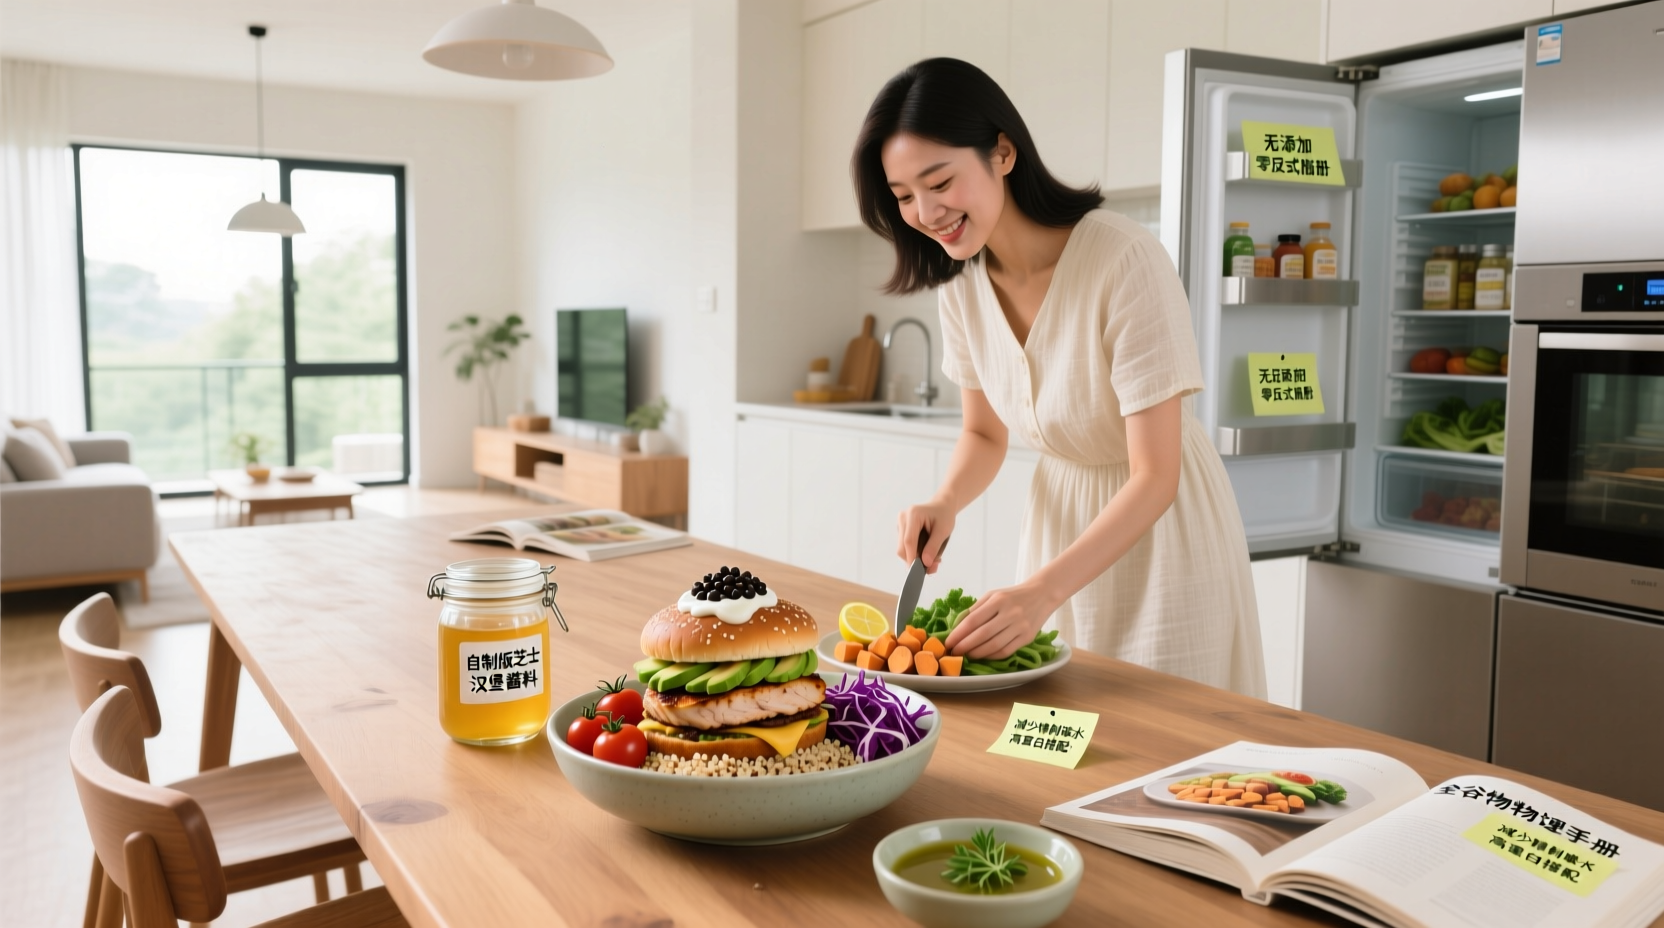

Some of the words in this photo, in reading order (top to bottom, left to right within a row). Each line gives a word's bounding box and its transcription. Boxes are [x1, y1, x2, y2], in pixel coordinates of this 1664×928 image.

[1264, 133, 1312, 154] 无添加
[467, 646, 540, 671] 自制版芝士
[468, 669, 538, 693] 汉堡酱料
